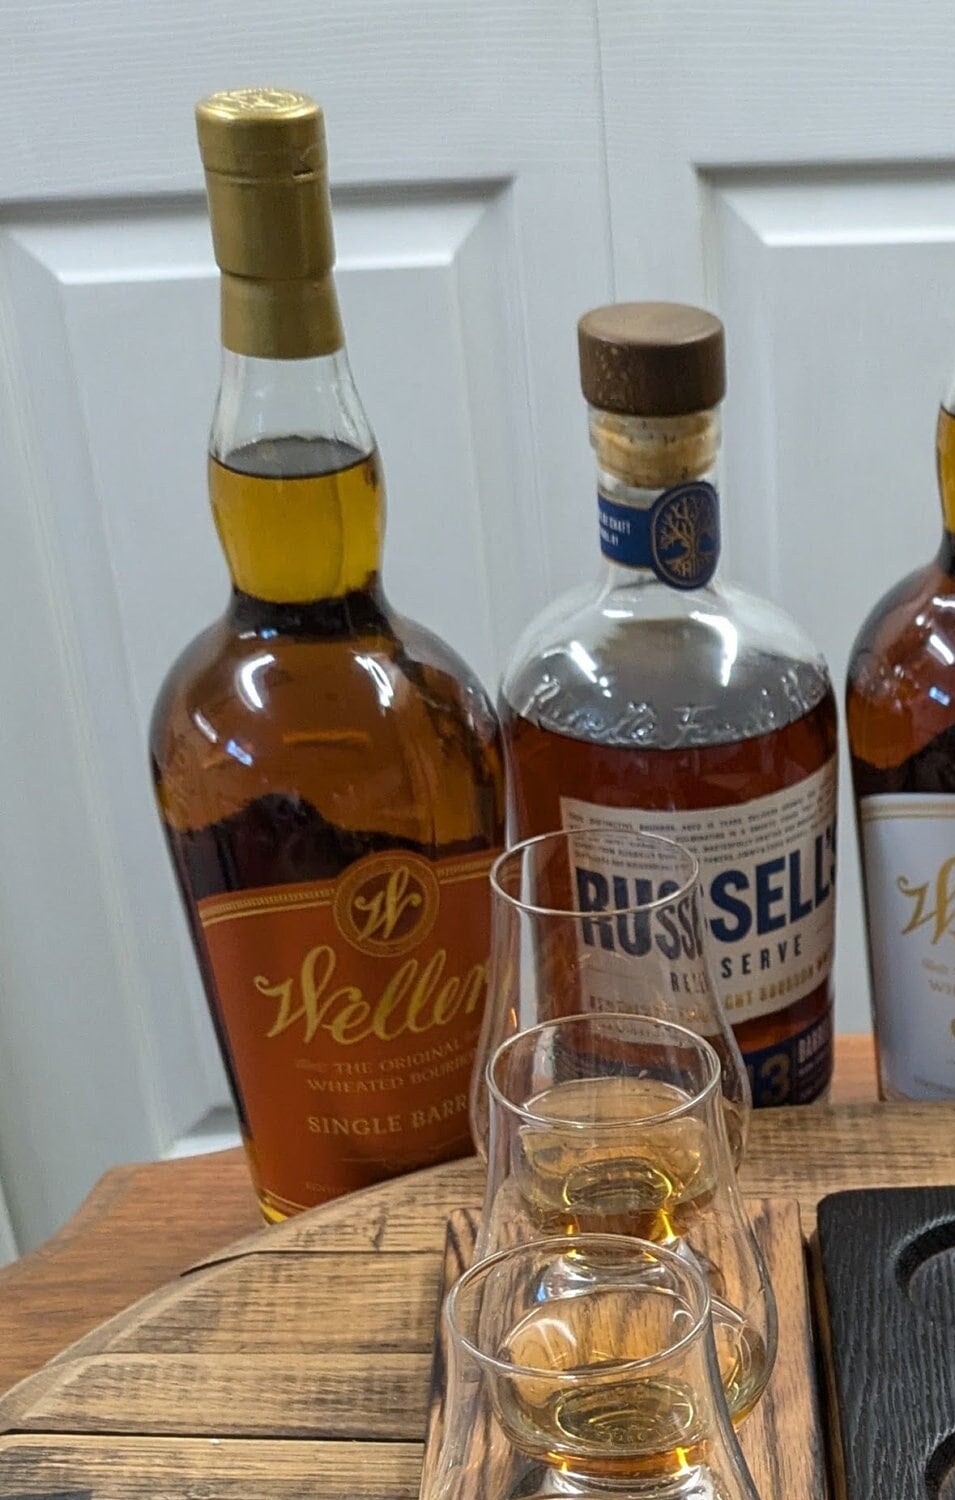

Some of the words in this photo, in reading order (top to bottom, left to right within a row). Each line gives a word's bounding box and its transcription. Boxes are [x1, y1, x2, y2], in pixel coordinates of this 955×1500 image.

[253, 945, 490, 1046] Weller
[379, 1039, 461, 1071] ORIGINAL
[307, 1115, 403, 1136] SINGLE
[411, 1094, 469, 1131] BARR
